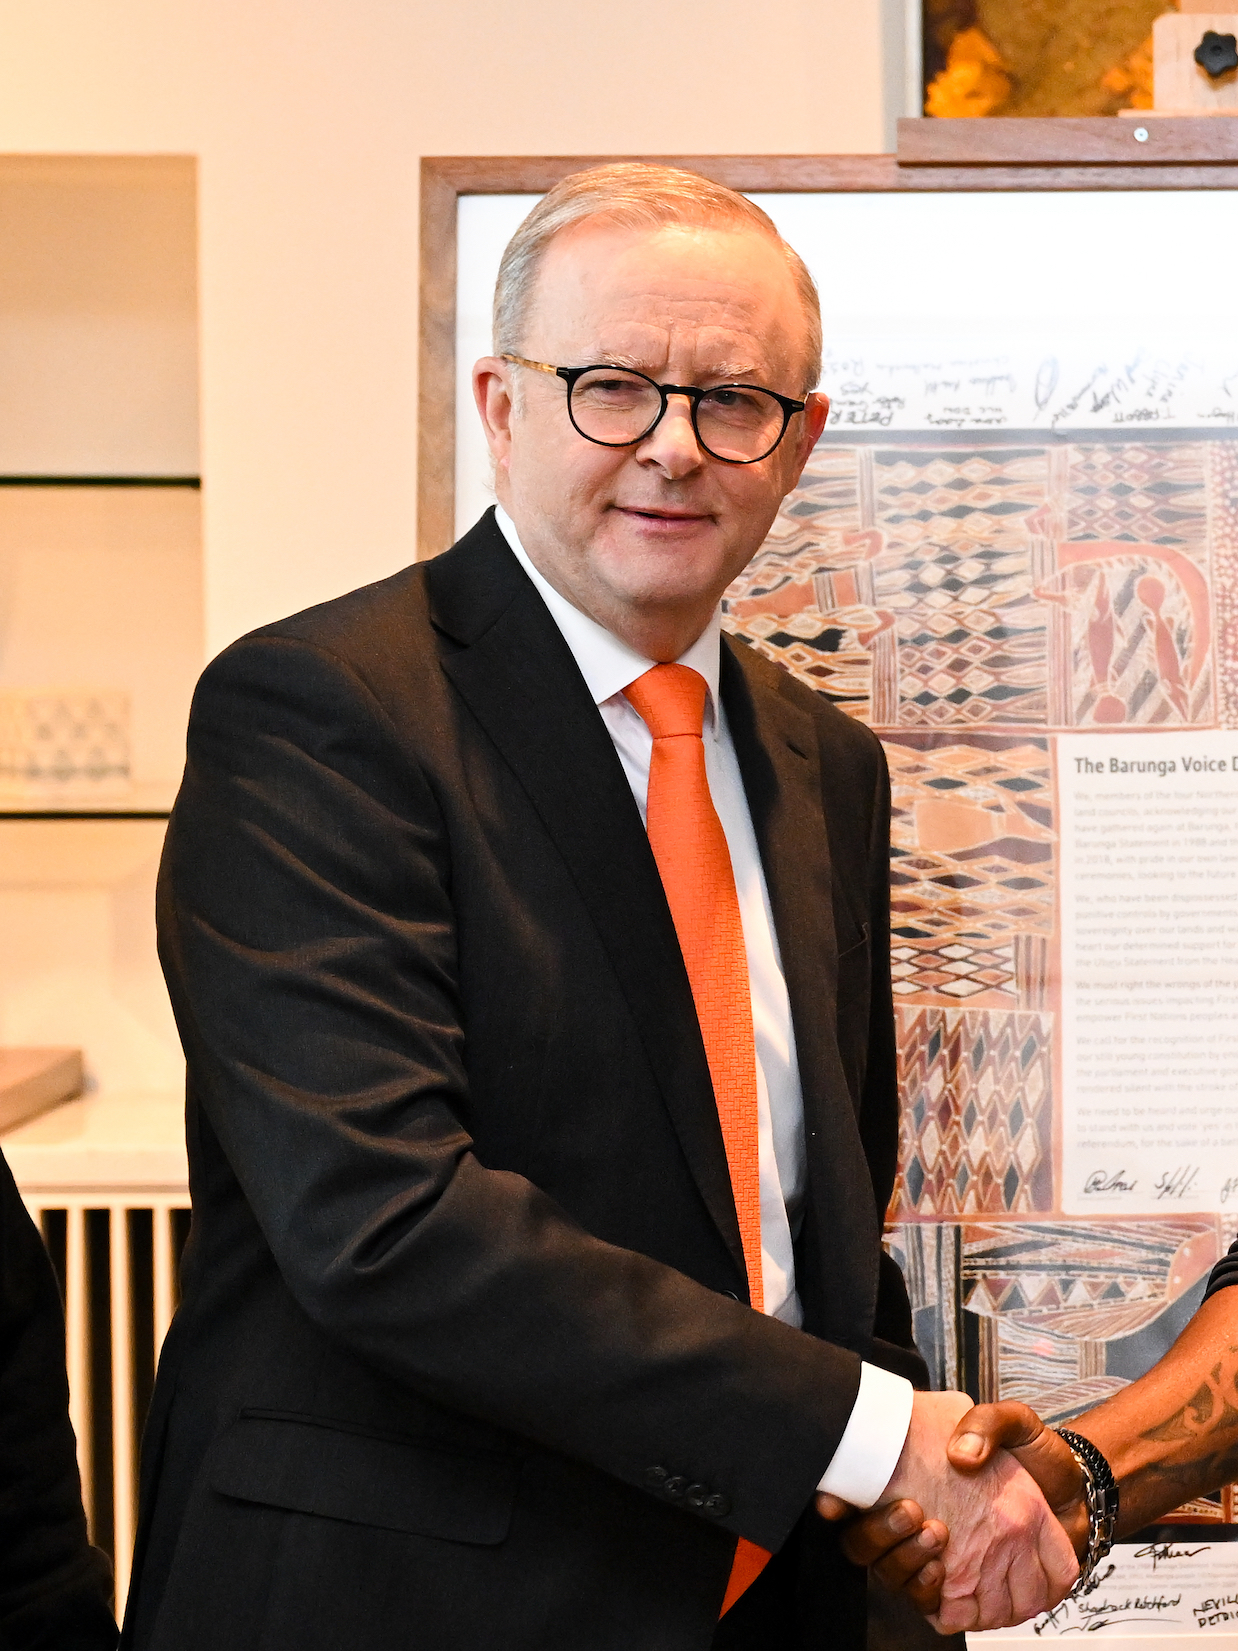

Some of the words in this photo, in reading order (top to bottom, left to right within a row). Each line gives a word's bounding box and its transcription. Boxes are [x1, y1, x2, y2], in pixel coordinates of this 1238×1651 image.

[1075, 757, 1104, 773] The
[1109, 757, 1176, 777] Barunga
[1181, 756, 1227, 772] Voice
